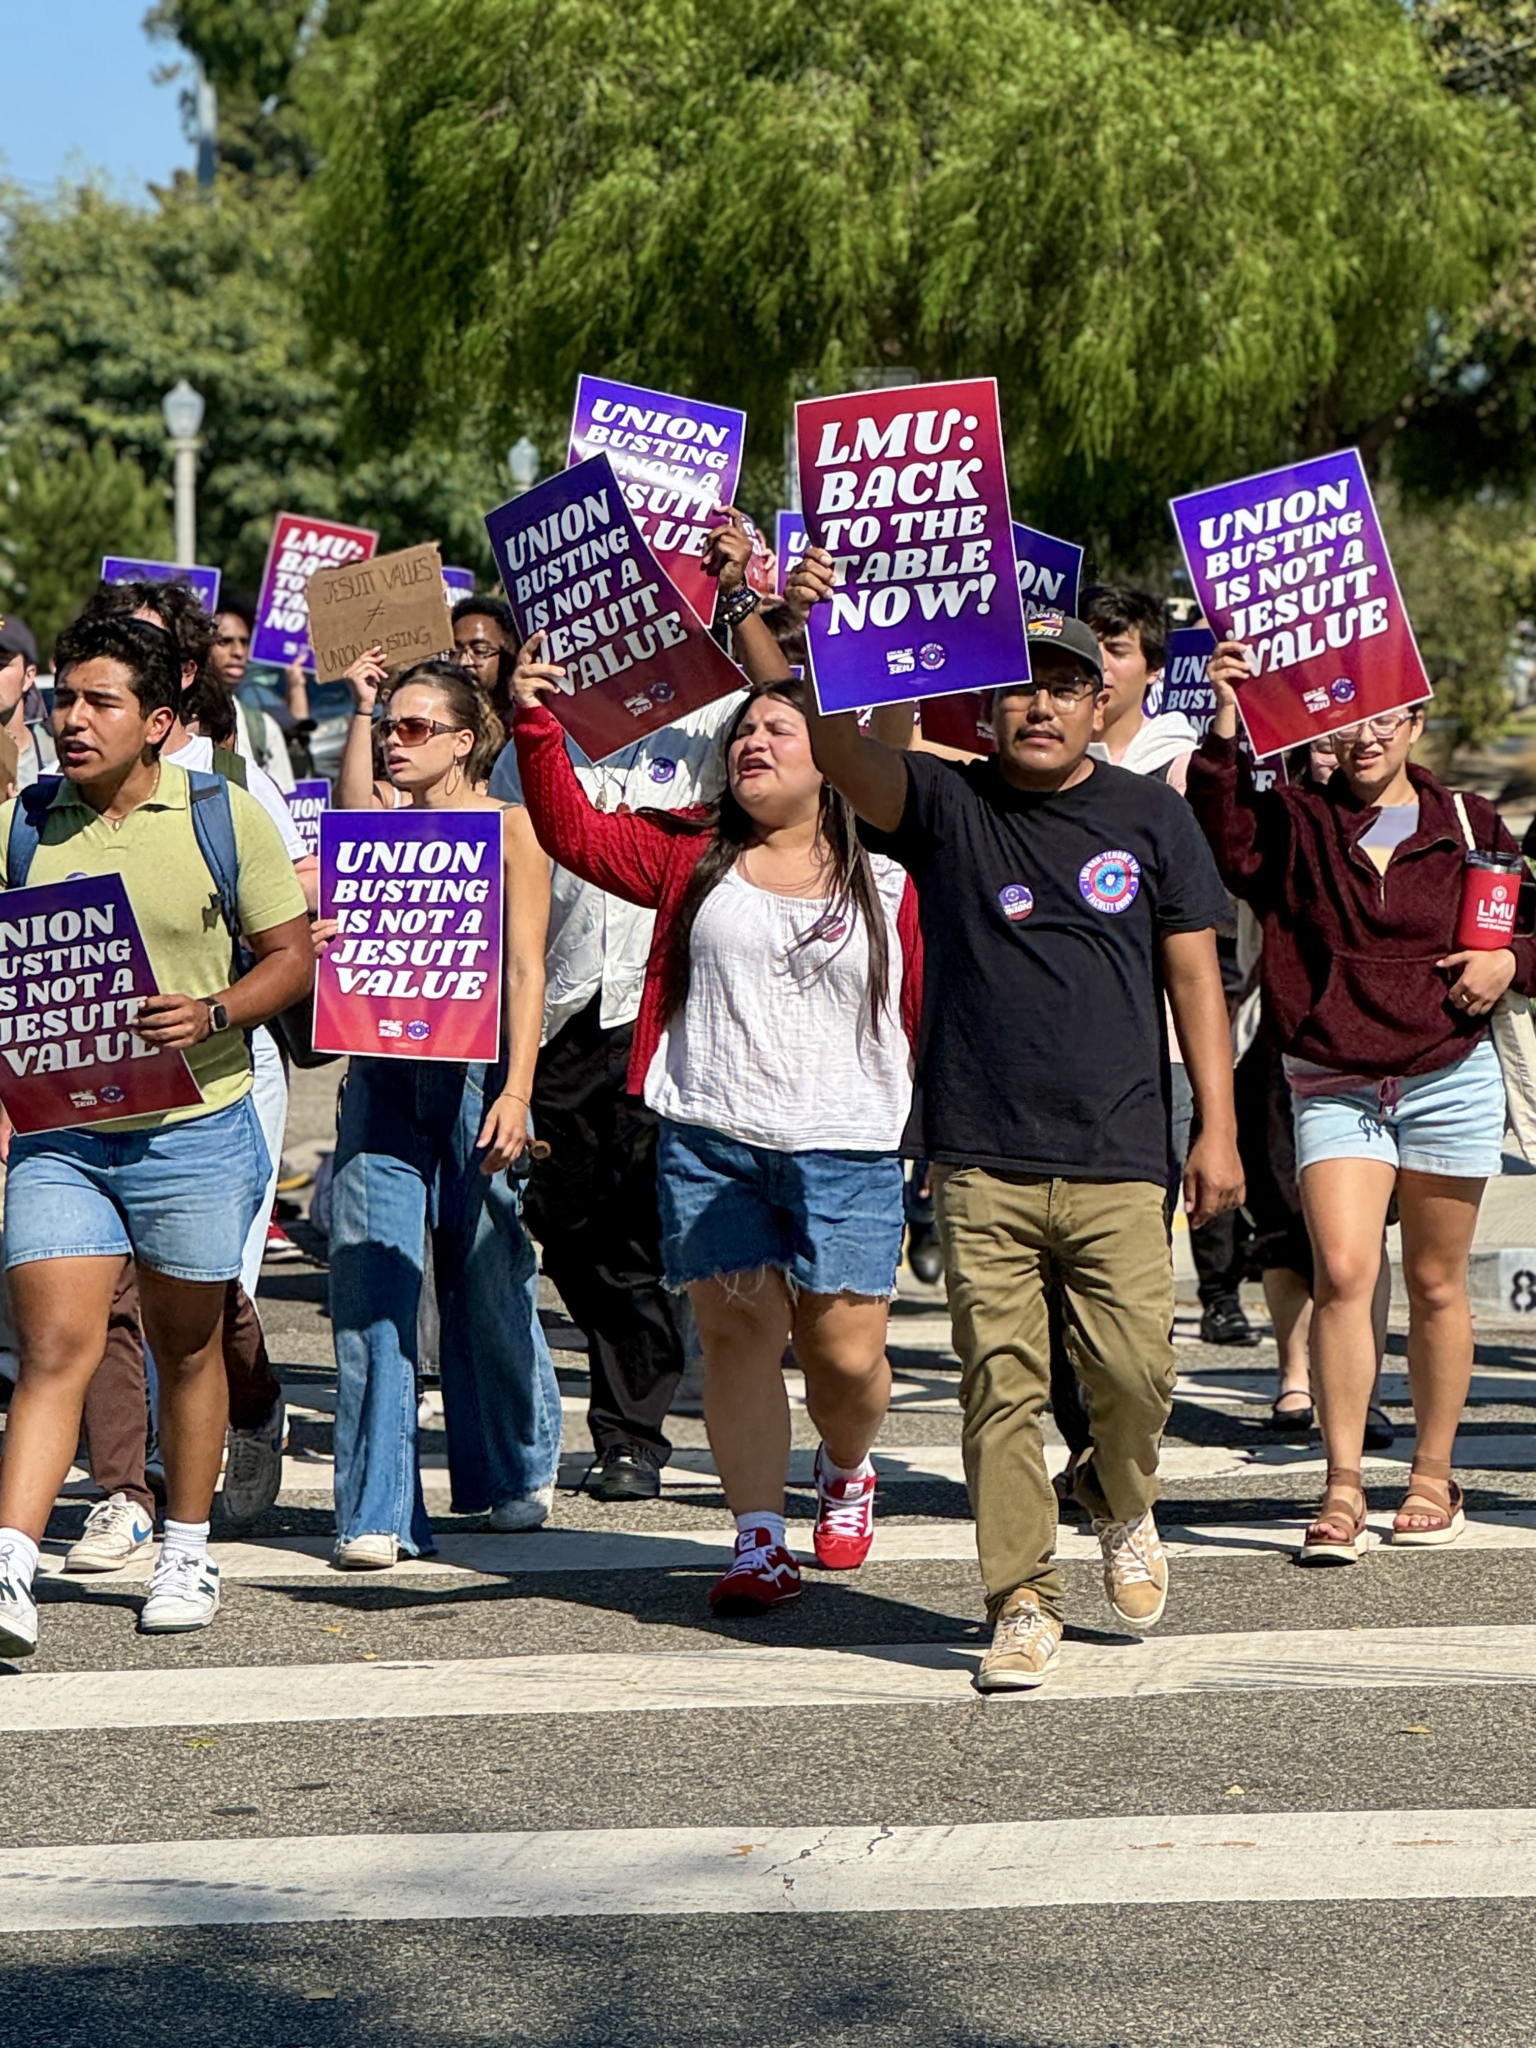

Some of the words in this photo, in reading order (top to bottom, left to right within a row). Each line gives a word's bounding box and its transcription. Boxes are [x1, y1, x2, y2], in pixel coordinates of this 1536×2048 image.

[591, 399, 729, 447] UNION
[815, 408, 978, 467] LMU:
[584, 424, 728, 470] BUSTING
[618, 481, 721, 521] SUIT
[816, 458, 983, 515] BACK
[505, 488, 610, 571] UNION
[820, 516, 881, 551] TO
[890, 505, 988, 544] THE
[1199, 479, 1349, 549] UNION
[281, 527, 364, 561] LMU:
[515, 525, 629, 604] BUSTING
[832, 539, 992, 587] TABLE
[1205, 510, 1364, 579] BUSTING
[275, 571, 307, 592] TO
[323, 570, 377, 605] JESUIT
[379, 556, 433, 590] VALUES
[525, 606, 549, 636] IS
[552, 569, 612, 621] NOT
[620, 558, 642, 589] A
[1214, 575, 1251, 610] IS
[1258, 547, 1334, 595] NOT
[1339, 539, 1364, 568] A
[535, 582, 659, 664] JESUIT
[827, 574, 997, 636] NOW!
[1225, 564, 1378, 641] JESUIT
[553, 611, 688, 696] VALUE
[1242, 597, 1388, 677] VALUE
[888, 664, 915, 675] SEIU
[1166, 689, 1217, 710] BUST
[336, 842, 486, 873] UNION
[332, 880, 489, 903] BUSTING
[1478, 899, 1515, 920] LMU
[0, 904, 115, 951] NION
[337, 909, 371, 934] IS
[375, 909, 454, 934] NOT
[456, 909, 483, 934] A
[0, 938, 132, 979] USTING
[330, 940, 489, 967] JESUIT
[0, 986, 17, 1012] S
[26, 973, 103, 1008] NOT
[109, 968, 134, 994] A
[336, 967, 488, 1000] VALUE
